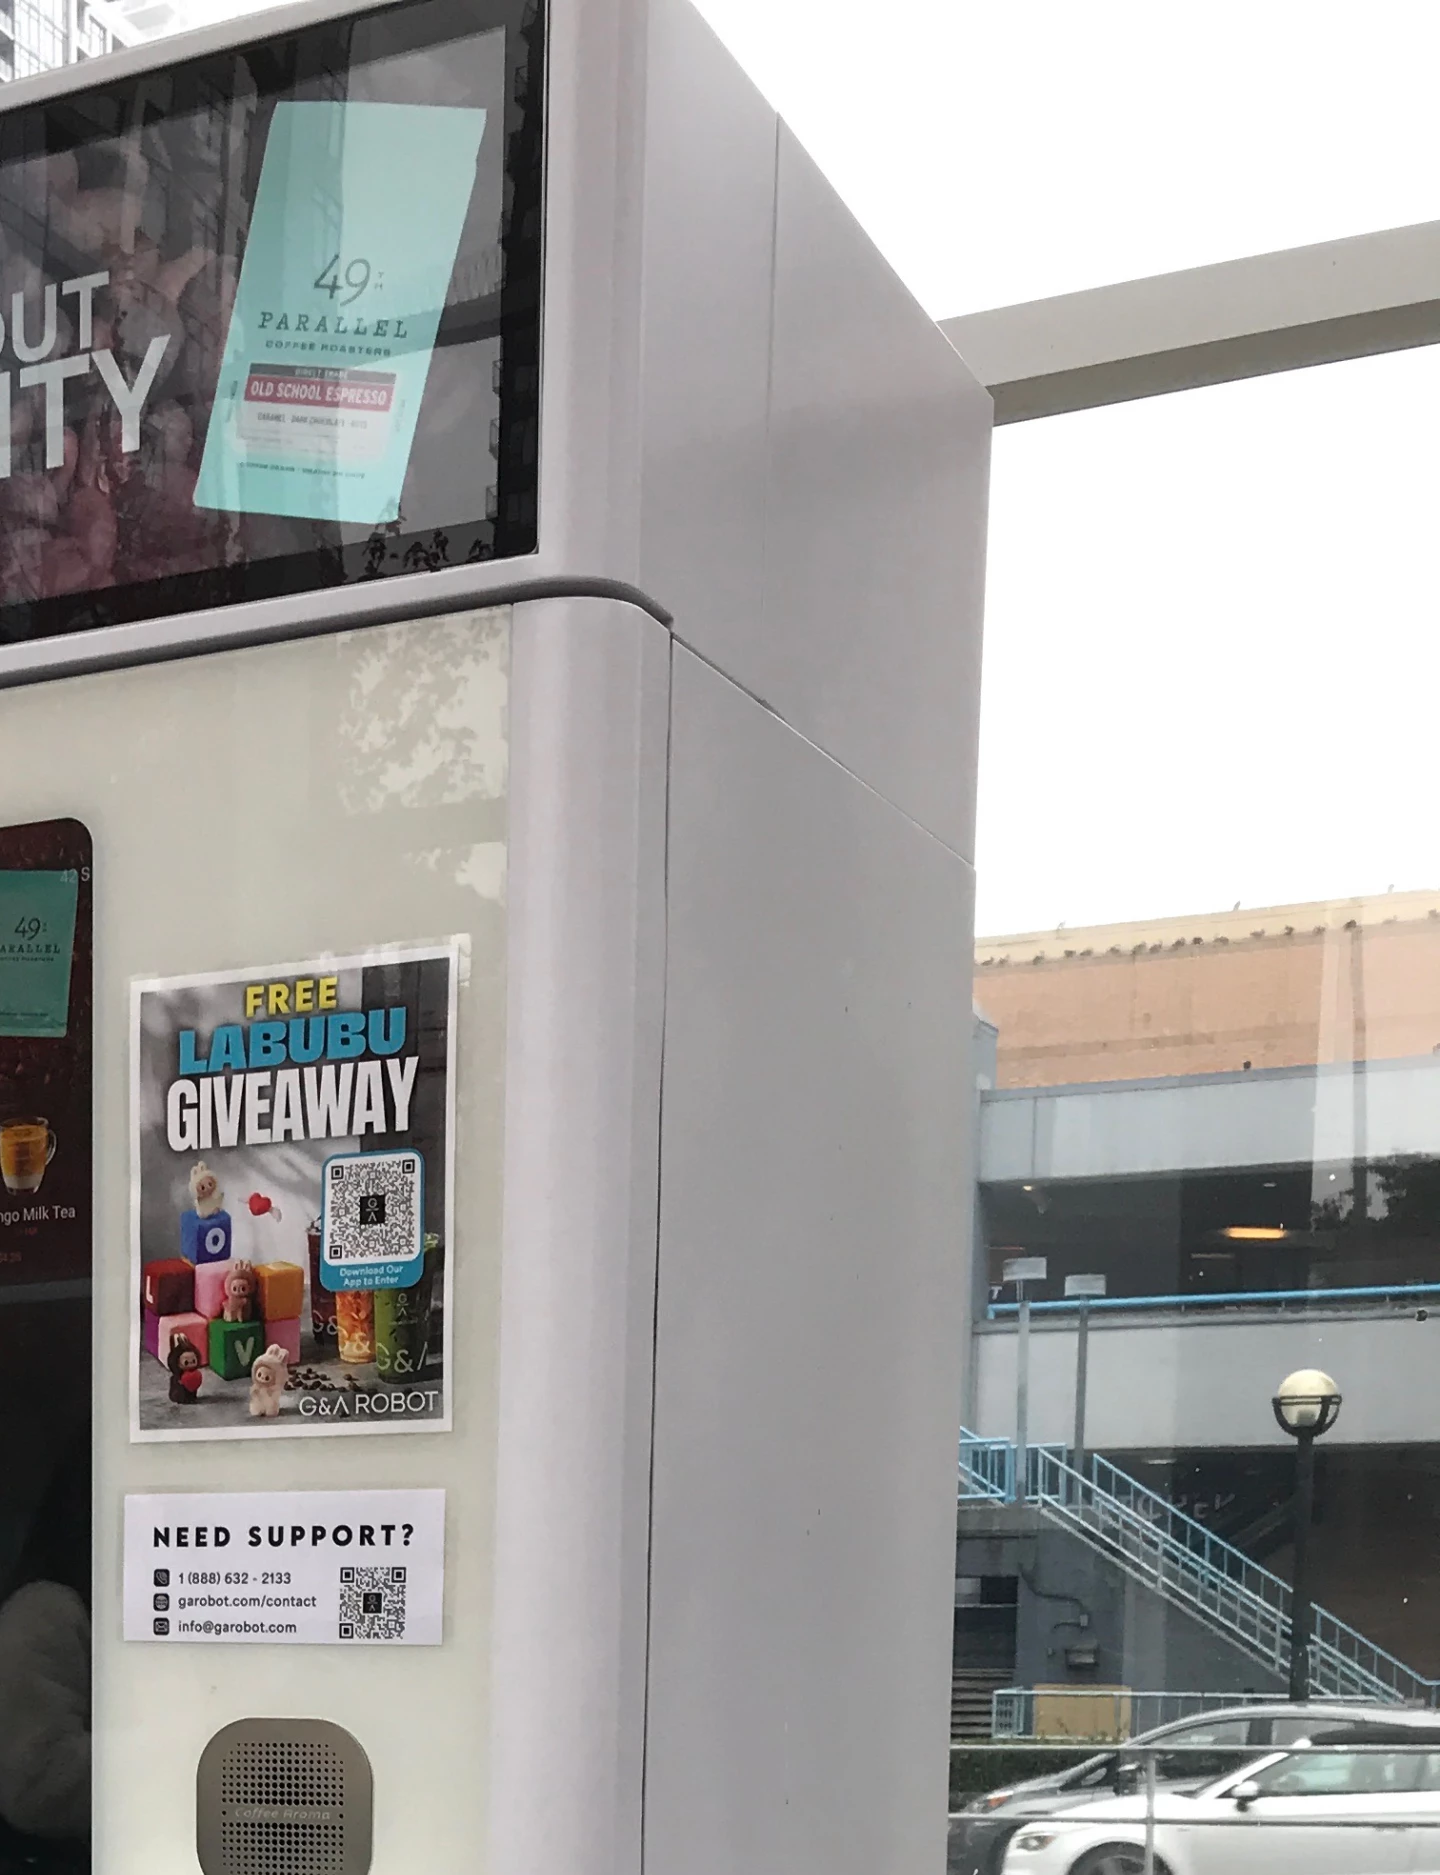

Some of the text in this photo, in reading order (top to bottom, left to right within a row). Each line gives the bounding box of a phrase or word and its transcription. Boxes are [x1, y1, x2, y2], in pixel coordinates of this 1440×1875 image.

[313, 253, 371, 307] 49
[257, 311, 408, 339] PARALLEL
[265, 339, 391, 357] COFFEE ROASTERS
[250, 381, 388, 406] OLD SCHOOL ESPRESSO
[244, 976, 338, 1018] FREE
[179, 1006, 407, 1076] LABUBU
[167, 1056, 420, 1152] GIVEAWAY
[23, 1205, 49, 1221] Milk
[52, 1205, 76, 1219] Tea
[340, 1264, 404, 1278] Download Our
[343, 1275, 399, 1288] App to Enter
[355, 1391, 439, 1415] ROBOT
[153, 1523, 414, 1548] NEED SUPPORT?
[179, 1572, 184, 1584] 1
[188, 1572, 220, 1585] (888)
[224, 1572, 248, 1584] 632
[261, 1572, 291, 1584] 2133
[178, 1595, 317, 1610] garobot.com/contact
[178, 1620, 297, 1636] info@garobot.com
[235, 1807, 331, 1820] Coffee Aroma
